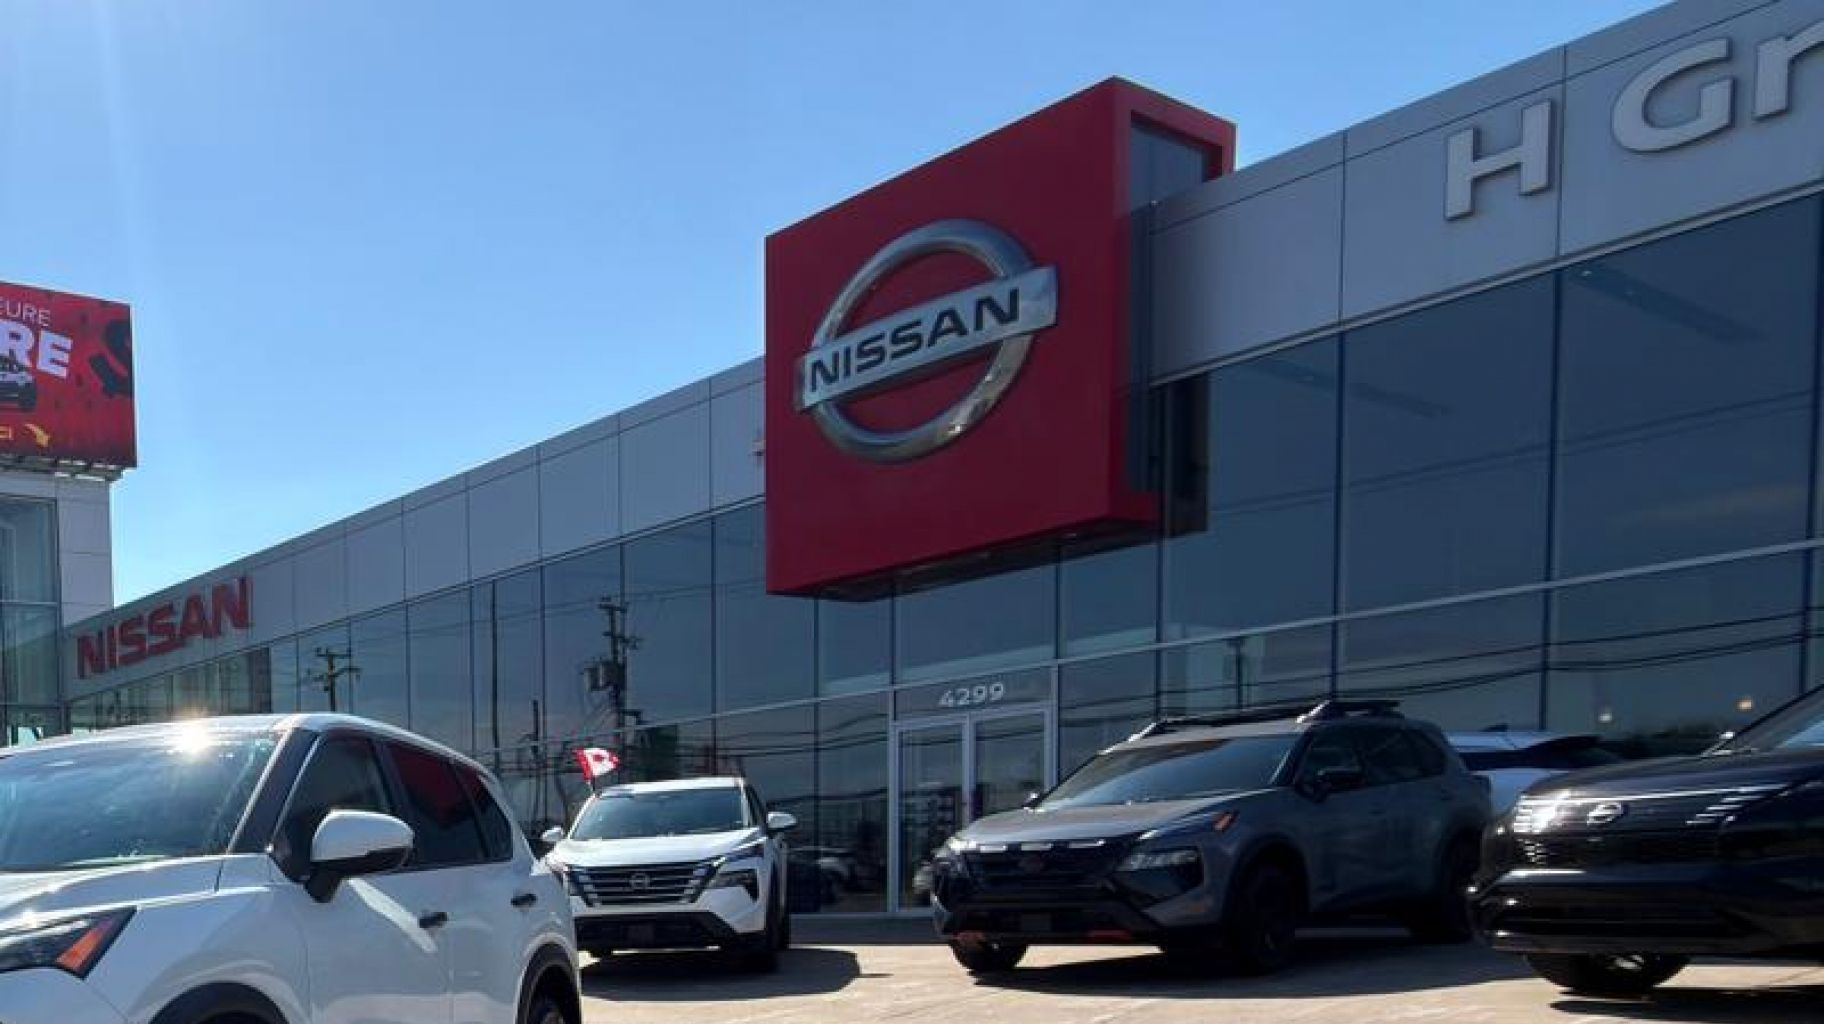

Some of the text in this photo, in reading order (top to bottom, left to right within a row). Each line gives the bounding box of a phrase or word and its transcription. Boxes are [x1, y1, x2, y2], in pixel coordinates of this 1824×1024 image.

[1445, 101, 1552, 220] H
[810, 288, 1019, 393] NISSAN
[77, 576, 252, 678] NISSAN
[940, 683, 1004, 707] 4299
